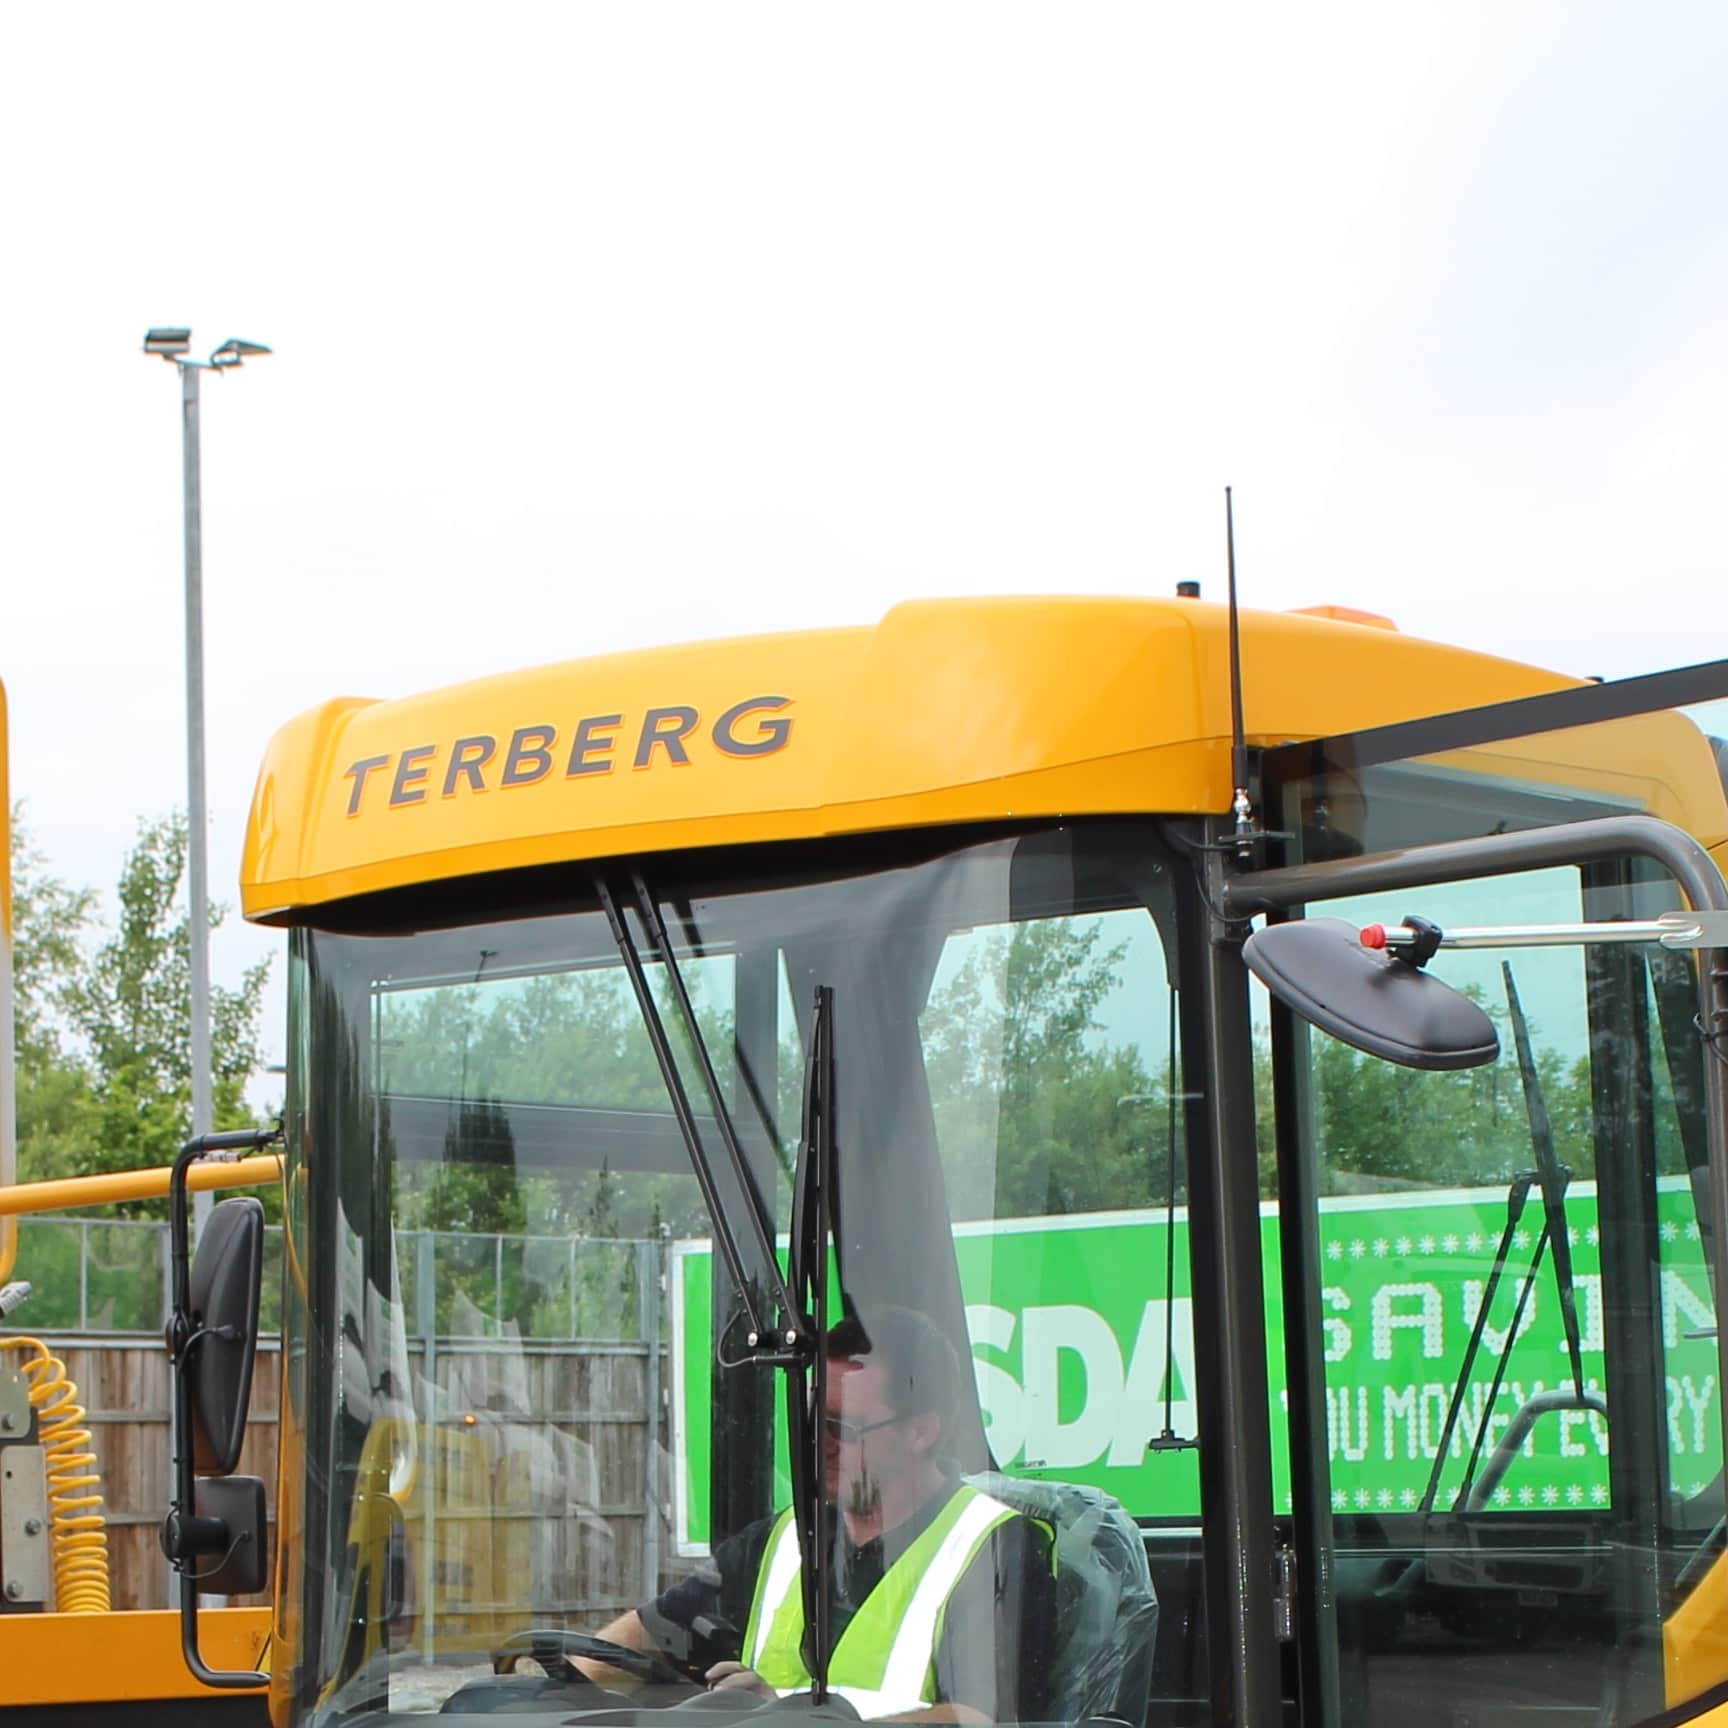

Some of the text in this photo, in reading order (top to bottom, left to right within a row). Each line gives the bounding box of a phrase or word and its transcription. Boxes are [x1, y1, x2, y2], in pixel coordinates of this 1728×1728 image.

[343, 696, 796, 818] TERBERG
[1321, 1273, 1718, 1361] AVIN
[964, 1297, 1199, 1468] SDA
